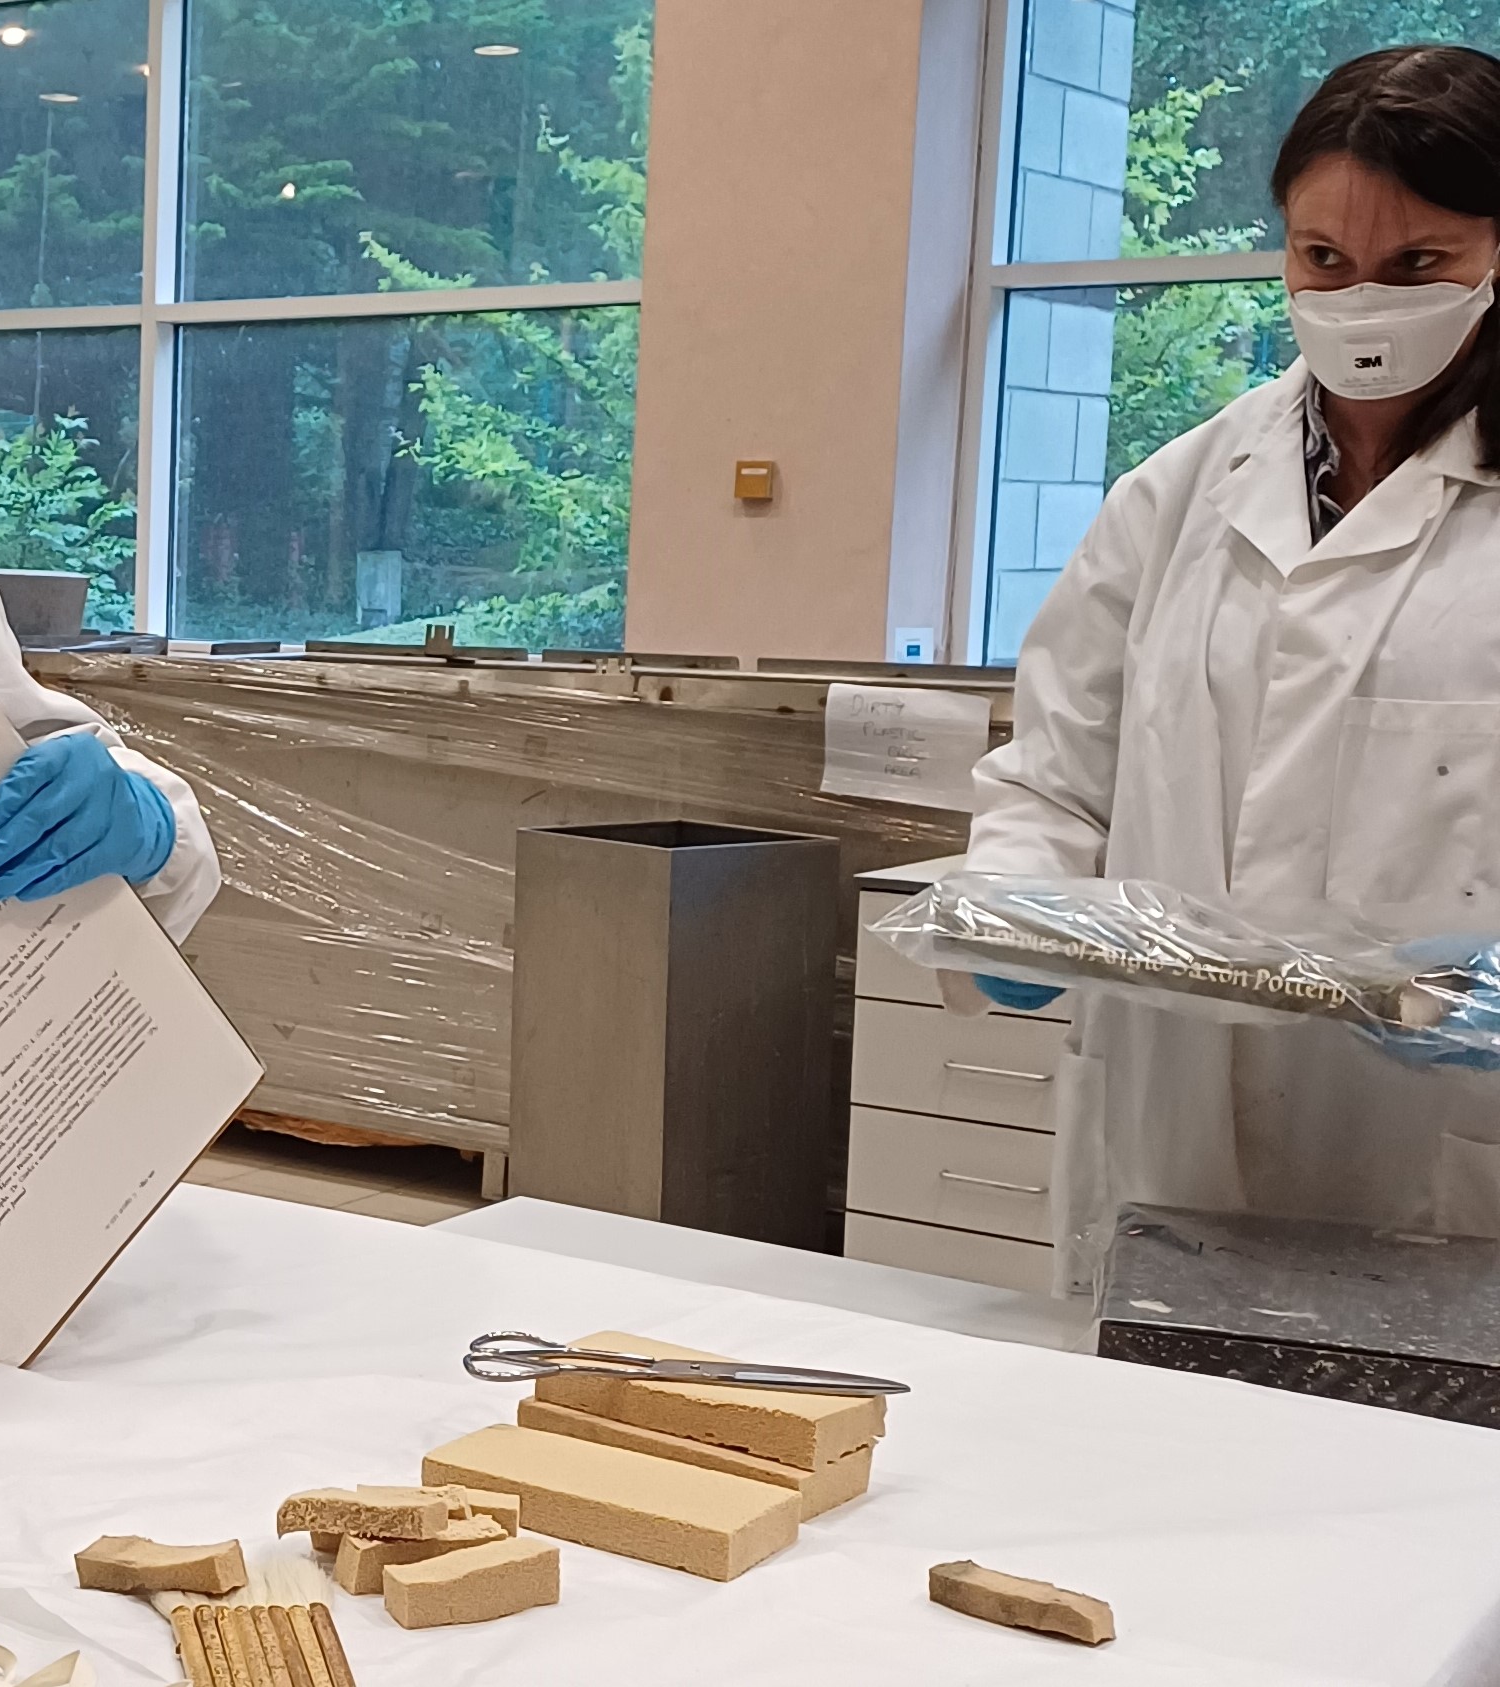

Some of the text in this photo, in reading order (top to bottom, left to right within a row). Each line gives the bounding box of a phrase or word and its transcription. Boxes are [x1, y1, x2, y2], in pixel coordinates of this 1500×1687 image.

[1354, 355, 1382, 369] 3M
[850, 693, 906, 717] DIRTY
[1252, 967, 1348, 1009] Pottery
